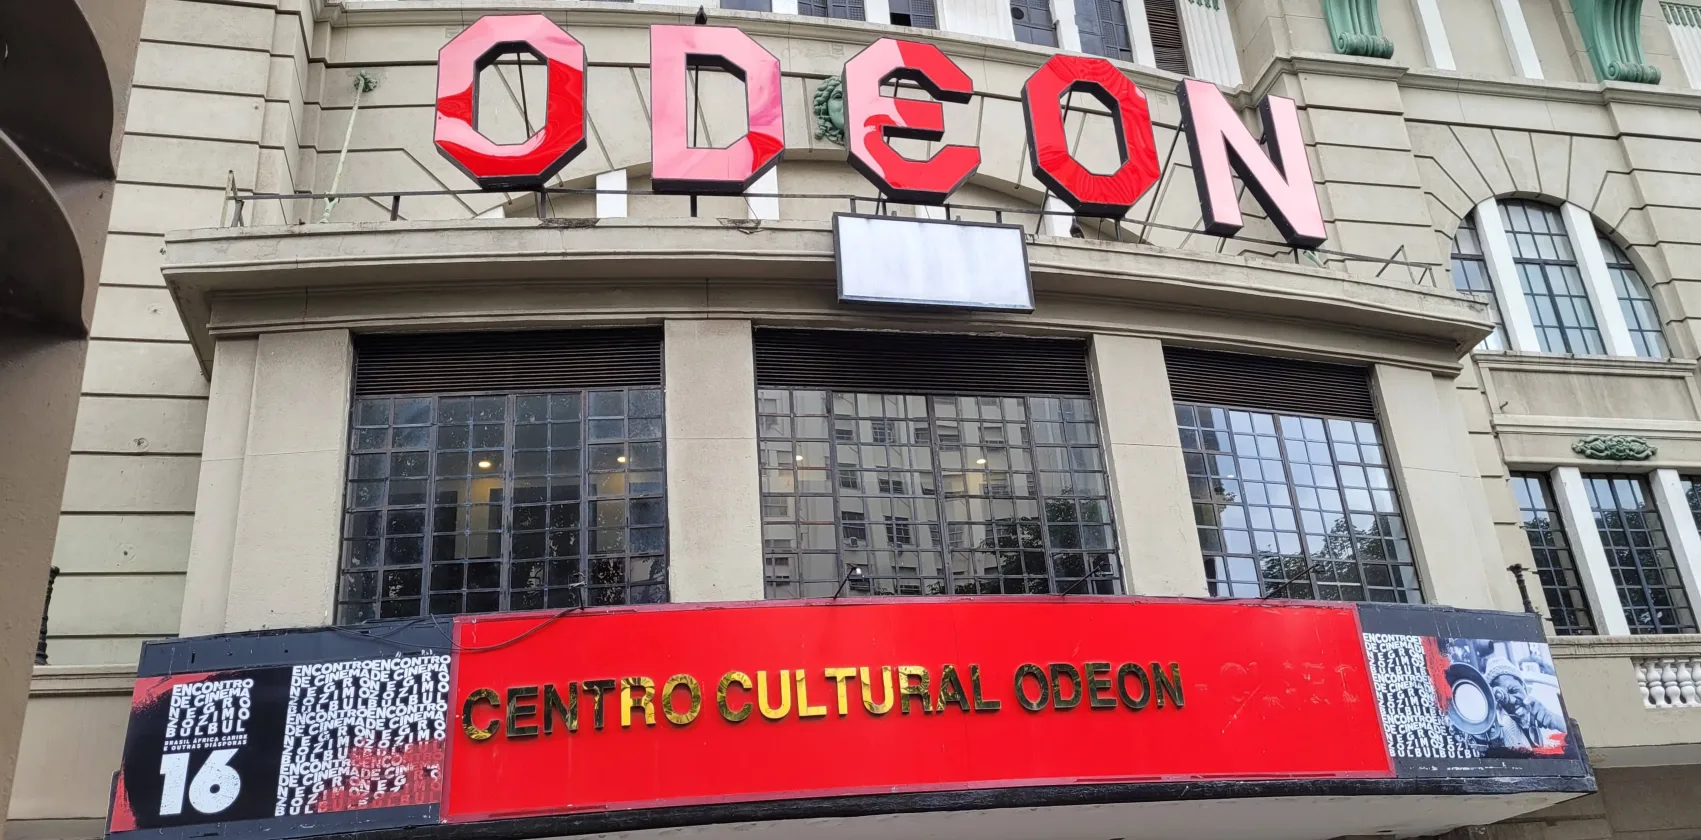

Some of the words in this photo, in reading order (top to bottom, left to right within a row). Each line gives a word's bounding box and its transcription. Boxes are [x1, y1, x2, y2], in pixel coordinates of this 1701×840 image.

[434, 14, 1328, 249] ODEON
[171, 695, 191, 708] DE
[194, 688, 250, 707] CINEMA
[173, 679, 254, 696] ENCONTRO
[462, 674, 701, 741] CENTRO
[718, 663, 1001, 723] CULTURAL
[1014, 661, 1186, 711] ODEON
[159, 748, 241, 816] 16
